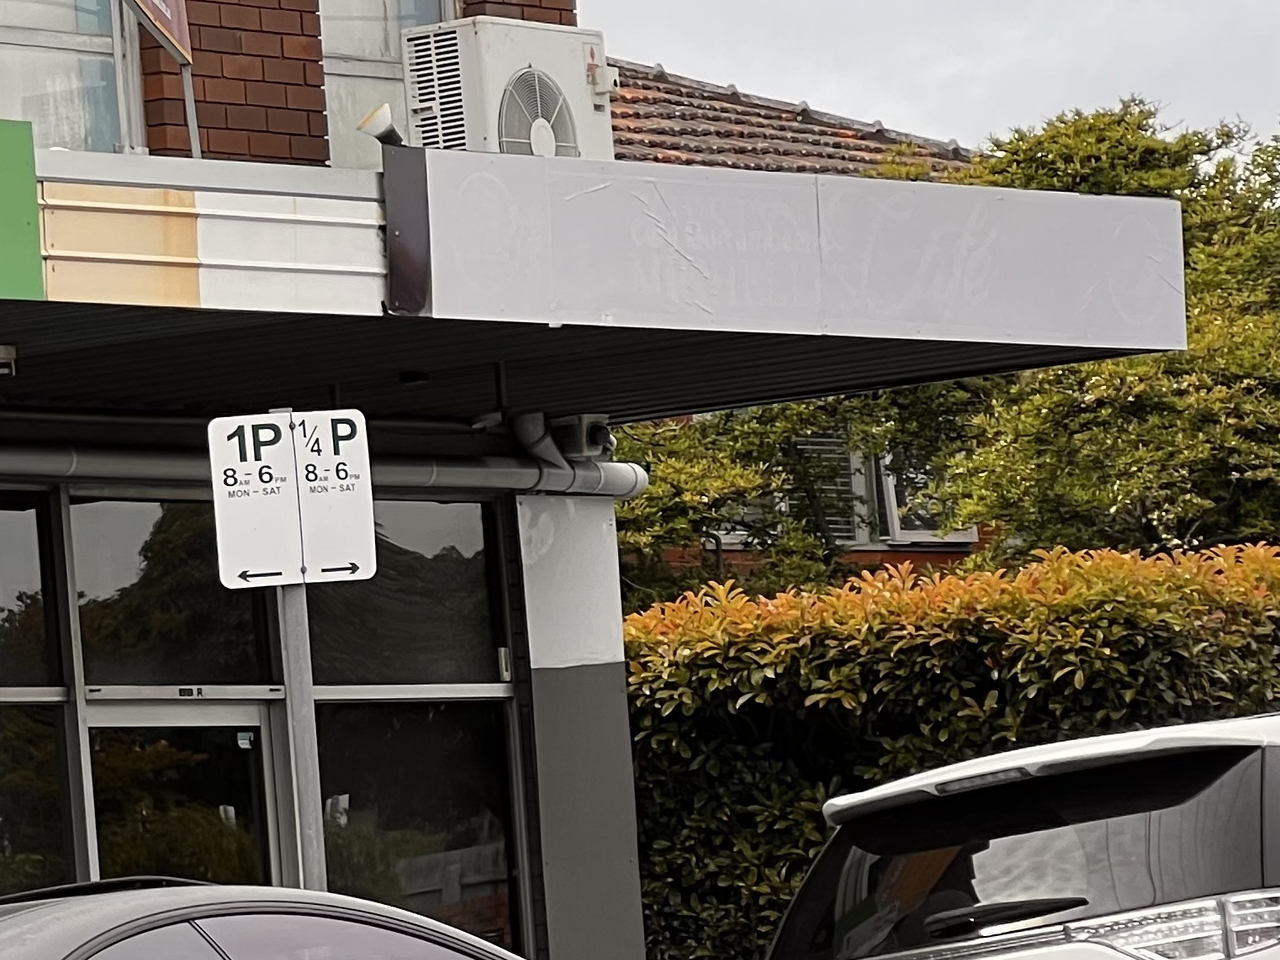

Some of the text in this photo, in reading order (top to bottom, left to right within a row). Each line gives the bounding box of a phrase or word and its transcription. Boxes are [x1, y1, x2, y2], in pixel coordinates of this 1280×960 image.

[226, 423, 282, 462] 1P
[228, 489, 250, 498] MON
[262, 486, 281, 495] SAT
[309, 485, 328, 494] MON
[339, 483, 355, 492] SAT
